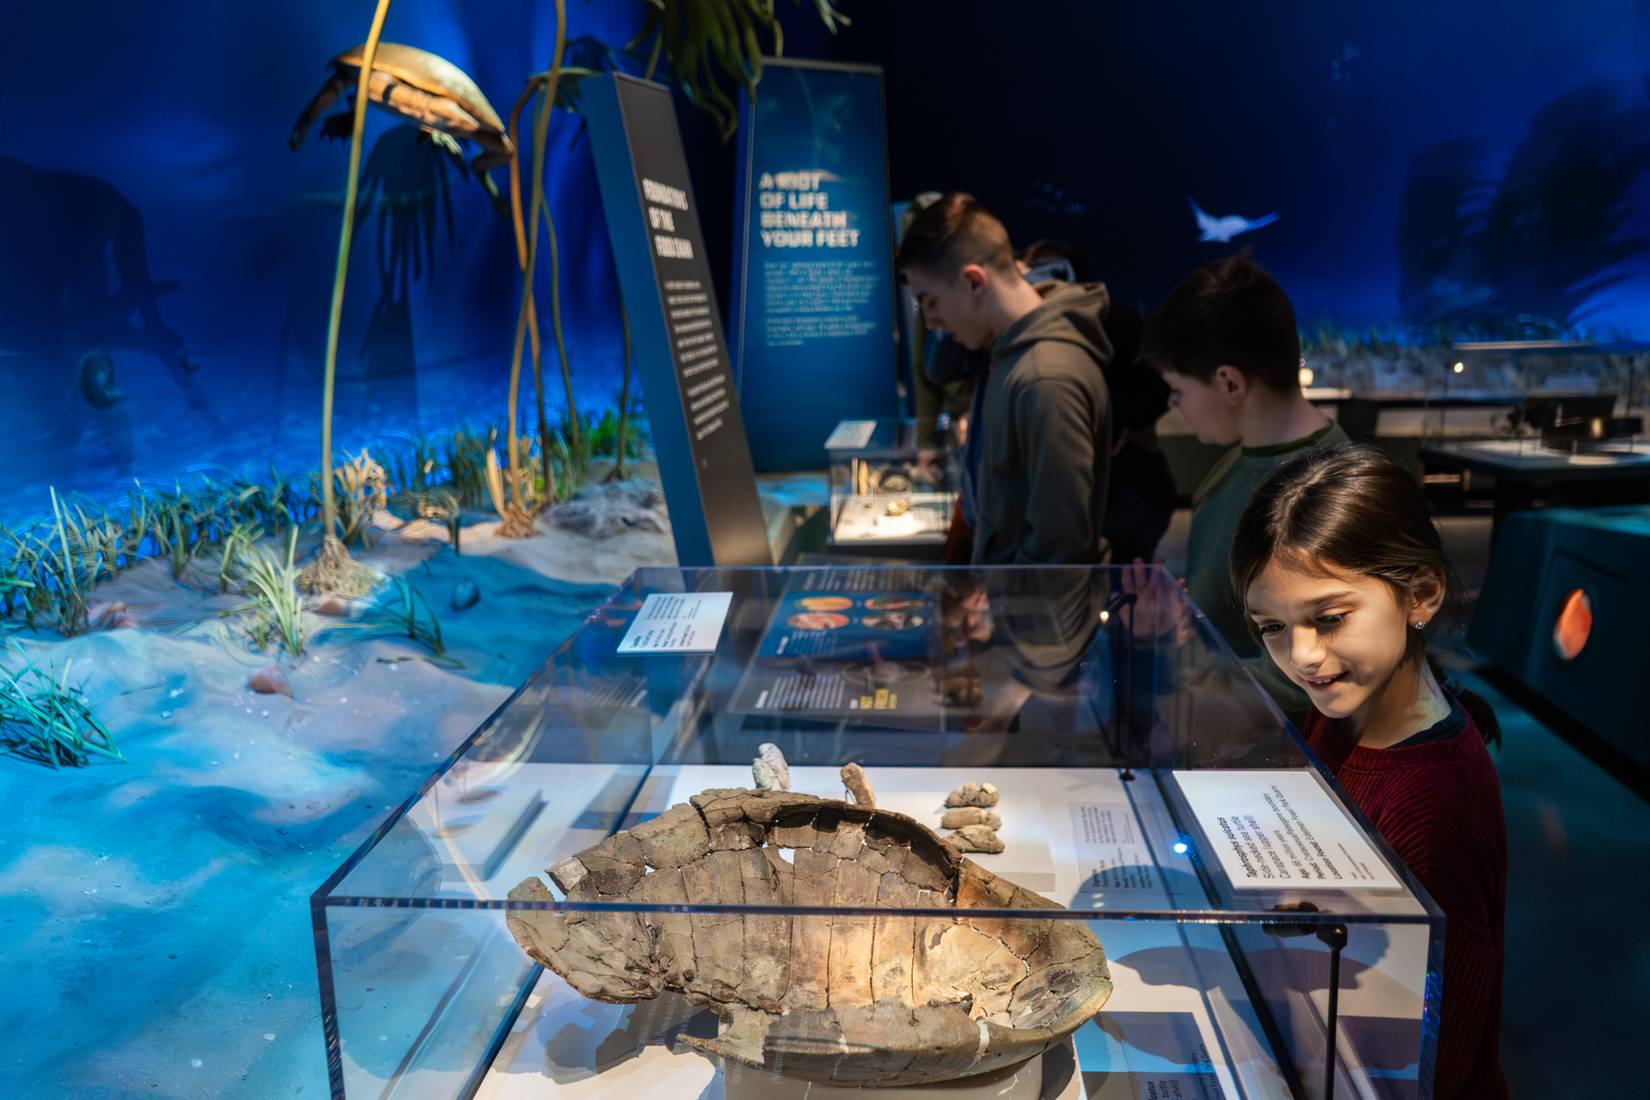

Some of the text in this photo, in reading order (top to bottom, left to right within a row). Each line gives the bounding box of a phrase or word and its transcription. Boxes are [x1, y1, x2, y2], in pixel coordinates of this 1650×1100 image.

[759, 171, 774, 191] A
[760, 192, 829, 210] OF LIFE
[760, 211, 848, 229] BENEATH
[761, 229, 860, 248] YOUR FEET
[1217, 816, 1237, 840] sulcatus
[1230, 816, 1275, 879] Side-necked sea turtle
[1266, 850, 1291, 879] Carapace
[1322, 858, 1343, 879] Location
